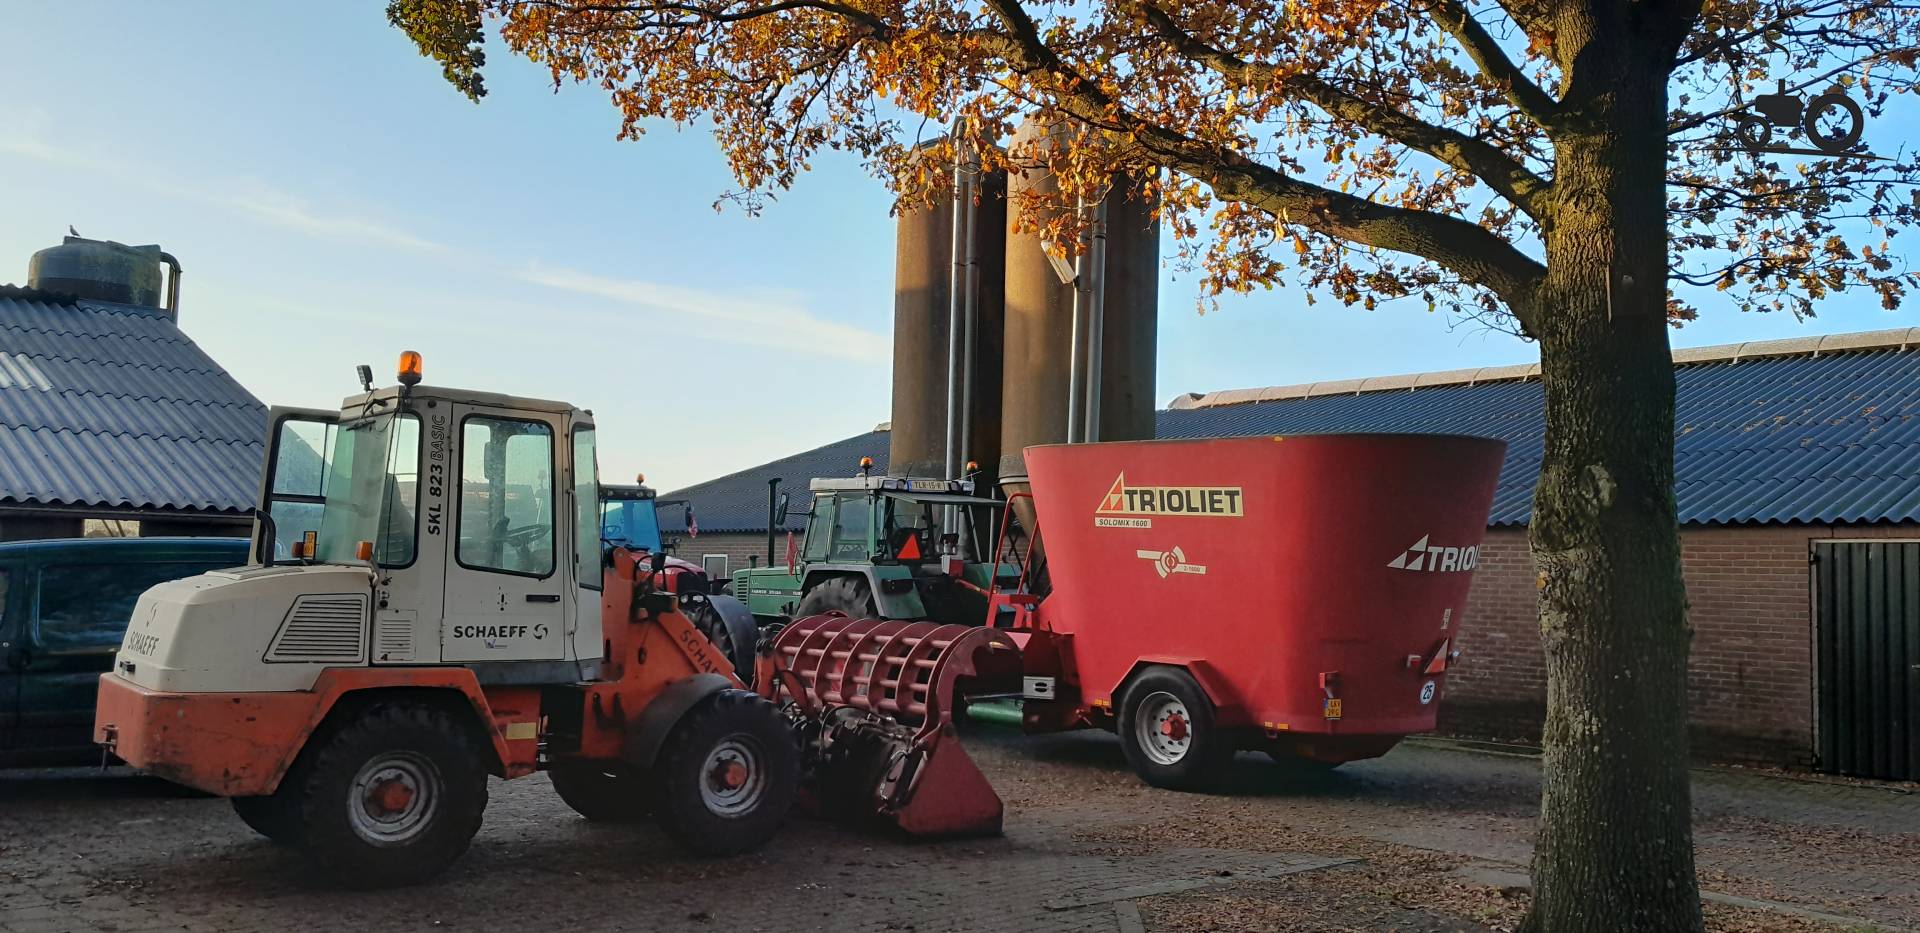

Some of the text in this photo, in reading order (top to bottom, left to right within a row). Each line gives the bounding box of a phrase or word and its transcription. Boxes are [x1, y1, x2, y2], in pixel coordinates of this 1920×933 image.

[428, 414, 446, 536] SKL 823 BASIC
[1124, 489, 1240, 513] TRIOLIET
[1099, 518, 1148, 527] SOLOMIX 1600
[453, 625, 528, 638] SCHAEFF
[128, 630, 160, 657] SCHAEFF
[1422, 684, 1433, 700] 25
